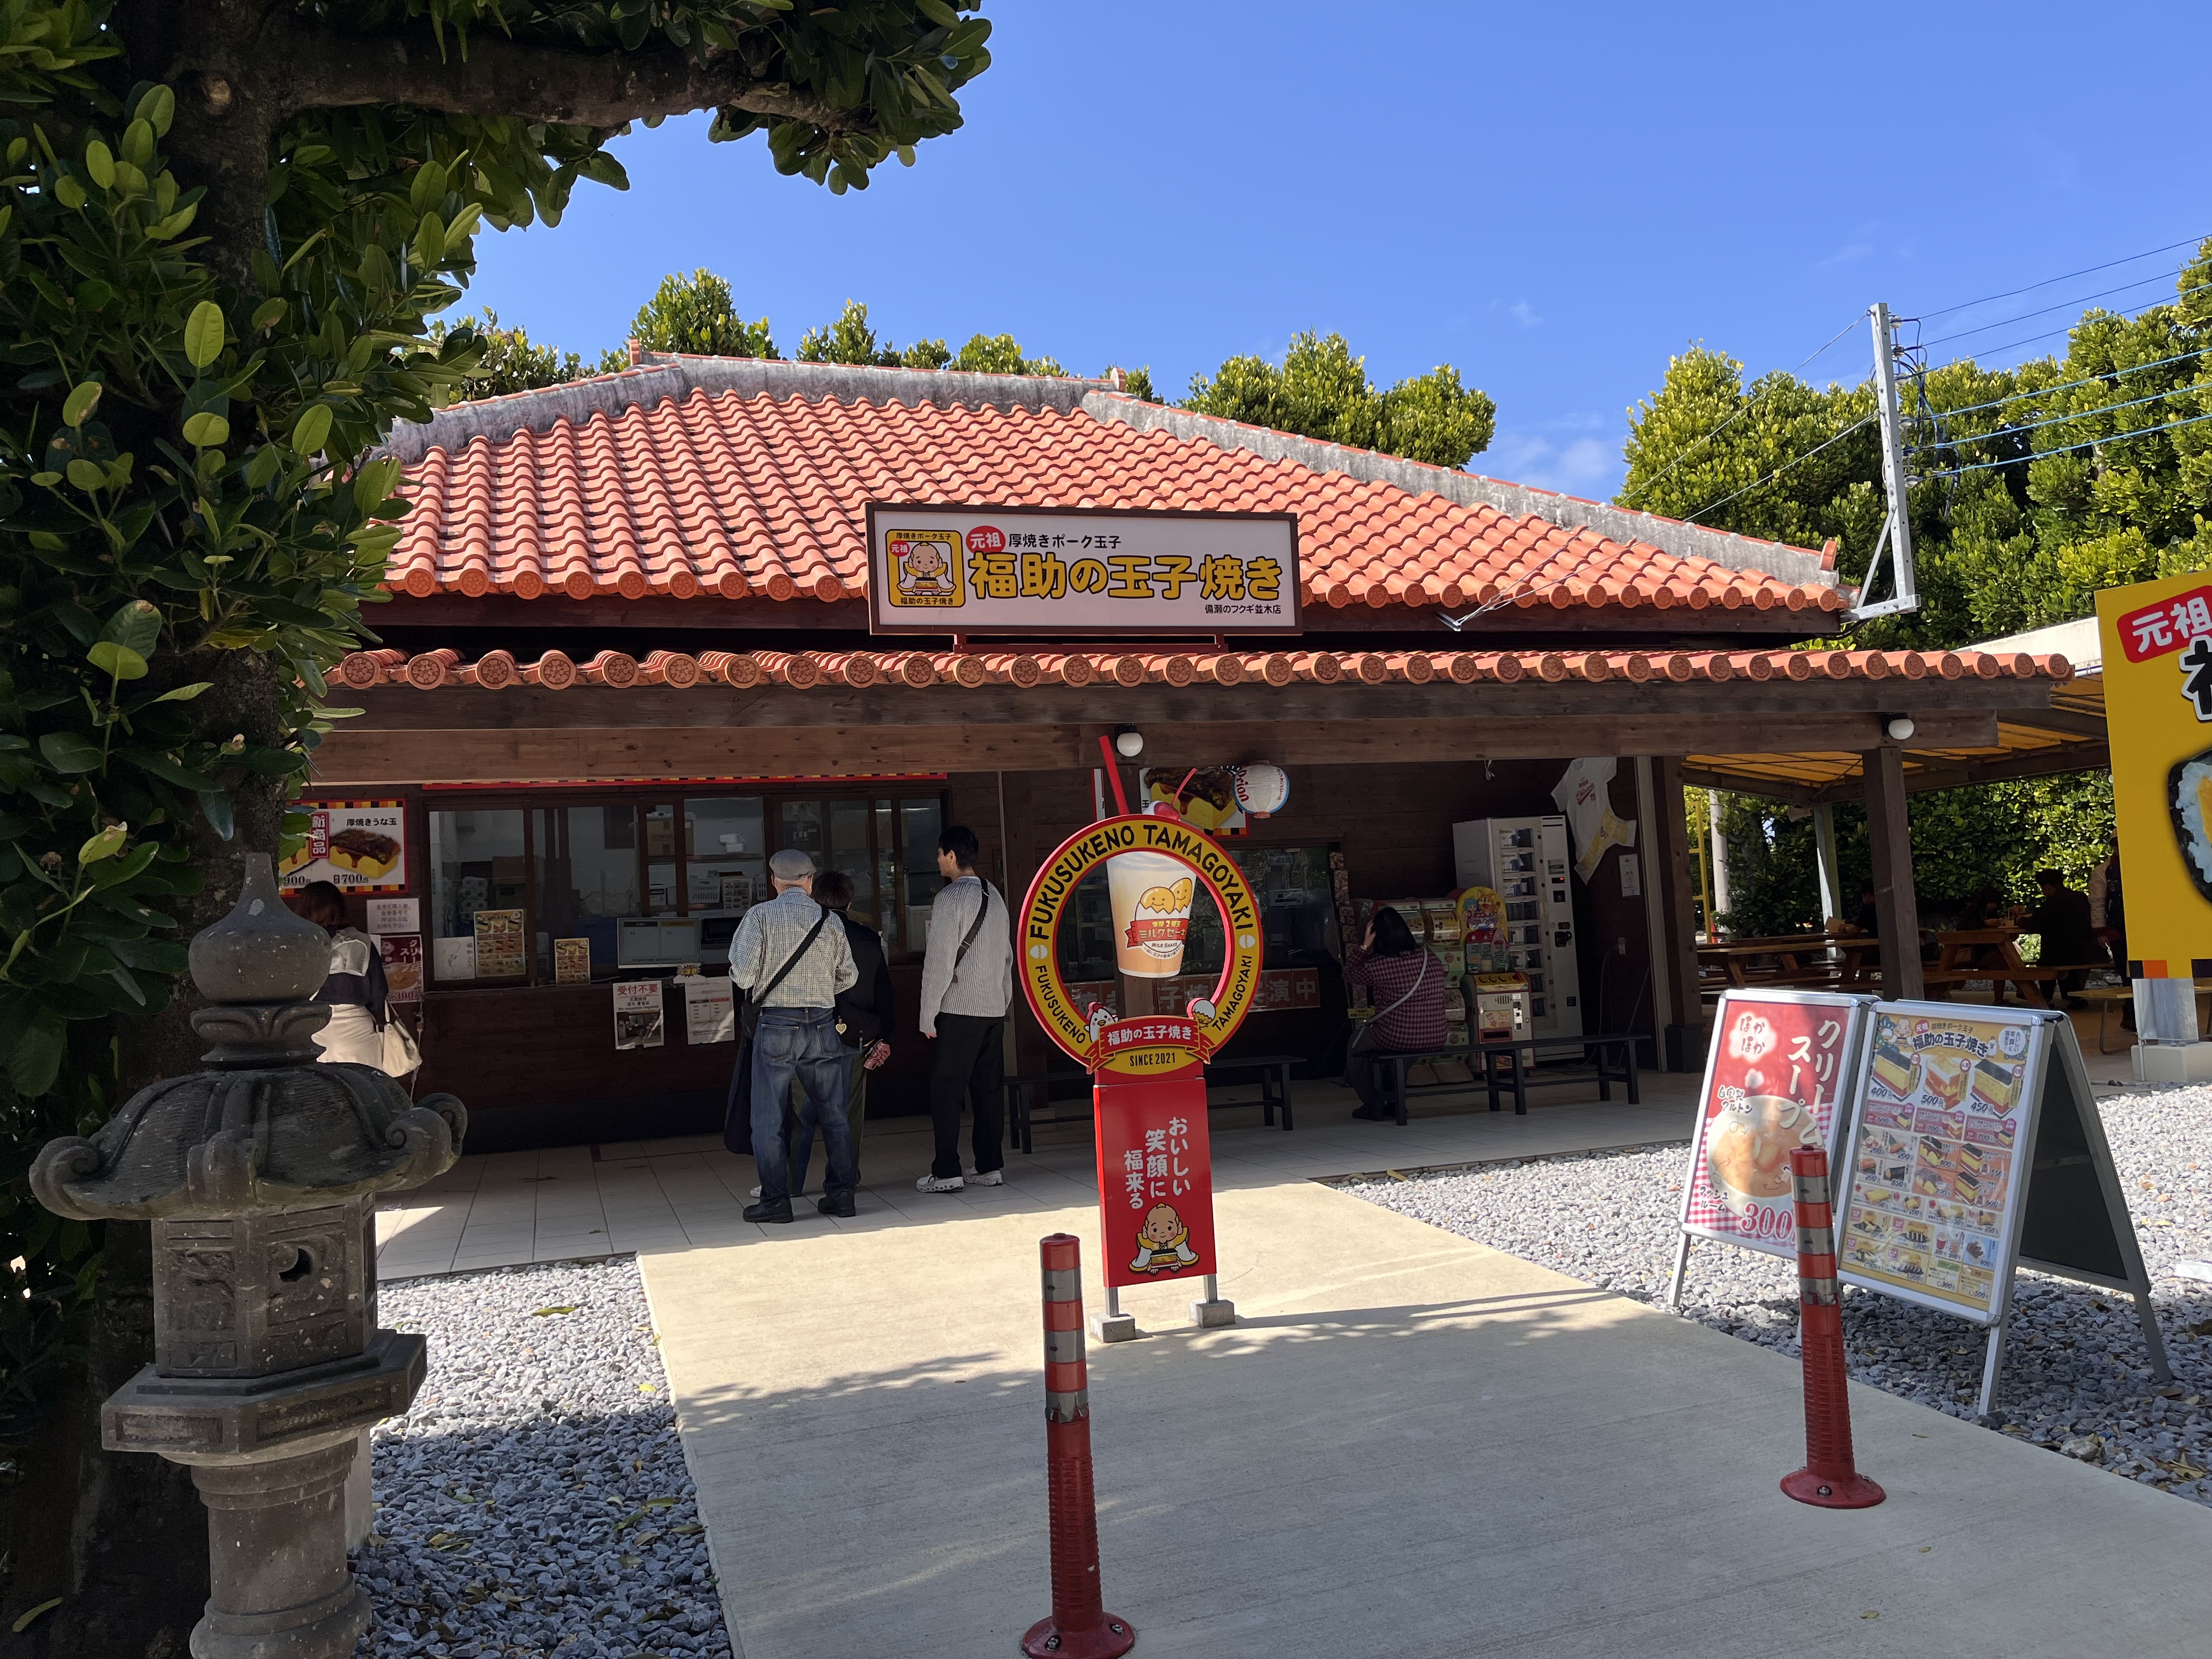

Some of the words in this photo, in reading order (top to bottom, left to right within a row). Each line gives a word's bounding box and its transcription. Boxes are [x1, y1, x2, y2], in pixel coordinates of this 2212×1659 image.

[891, 544, 909, 553] 元祖
[970, 532, 1002, 549] 元祖
[1008, 533, 1122, 549] 厚焼きポーク玉子
[968, 551, 1282, 601] 福助の玉子焼き
[900, 597, 954, 605] 福助の玉子焼き
[1205, 603, 1282, 615] 備瀬のフクギ並木店
[2132, 596, 2212, 653] 元祖
[1236, 769, 1250, 802] Orion
[346, 817, 398, 827] 厚焼きうな玉
[1029, 825, 1135, 940] FUKUSUKENO
[1143, 824, 1254, 930] TAMAGOYAKI
[617, 984, 658, 996] 受付不要
[1212, 955, 1253, 1032] TAMAGOYAKI
[1035, 964, 1086, 1045] FUKUSUKENO
[1740, 1015, 1765, 1034] ほか
[1916, 1022, 1928, 1032] 元祖
[1107, 1024, 1192, 1047] 福助の玉子焼き
[1741, 1036, 1765, 1054] ほか
[1912, 1031, 1989, 1058] 福助の玉子焼き
[1129, 1054, 1153, 1067] SINCE
[1155, 1052, 1176, 1065] 2021
[1777, 1035, 1812, 1129] スープ
[1799, 1019, 1841, 1147] クリーム
[1722, 1101, 1753, 1114] クルトン
[1145, 1128, 1169, 1198] 笑顔に
[1169, 1116, 1191, 1196] おいしい
[1124, 1149, 1145, 1210] 福来る
[1700, 1186, 1729, 1200] マッシュ
[1701, 1200, 1725, 1212] ルーム
[1741, 1203, 1795, 1243] 300
